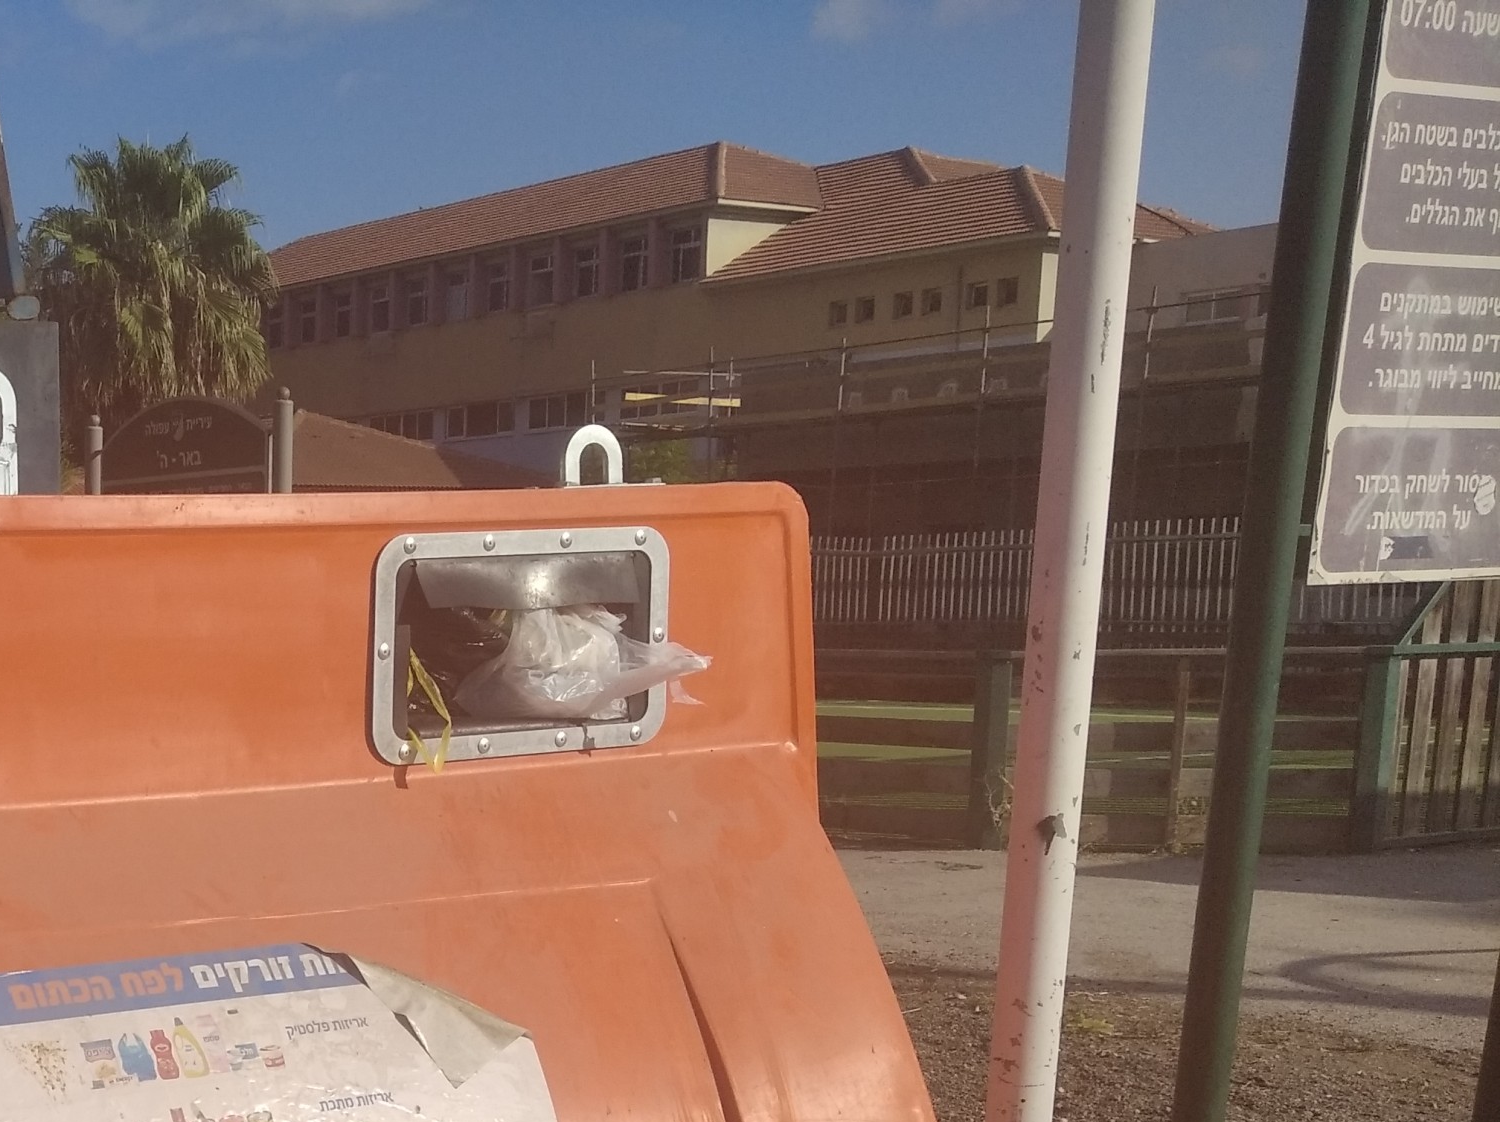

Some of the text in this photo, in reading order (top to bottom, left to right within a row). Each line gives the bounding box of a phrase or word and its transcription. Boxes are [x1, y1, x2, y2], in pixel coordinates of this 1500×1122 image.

[1401, 0, 1456, 31] 07:00
[1381, 121, 1410, 149] הגן.
[1414, 124, 1457, 147] בשטח
[1400, 158, 1452, 187] הכלבים
[1457, 161, 1488, 190] בעלי
[1405, 198, 1460, 226] הגללים.
[1462, 206, 1486, 227] את
[1380, 291, 1452, 319] במתקנים
[1362, 323, 1375, 349] 4
[1380, 323, 1414, 350] לגיל
[1416, 332, 1467, 352] מתחת
[1368, 368, 1421, 388] מבוגר.
[1428, 364, 1458, 389] ליווי
[1355, 474, 1401, 494] בכדור
[1405, 468, 1451, 500] לשחק
[1366, 503, 1472, 530] על המדשאות.
[121, 962, 183, 998] לפח
[189, 955, 294, 993] זורקים
[8, 976, 115, 1010] הכתום
[285, 1017, 369, 1040] אריזות פלסטיק
[319, 1091, 394, 1112] אריזות מתכת
